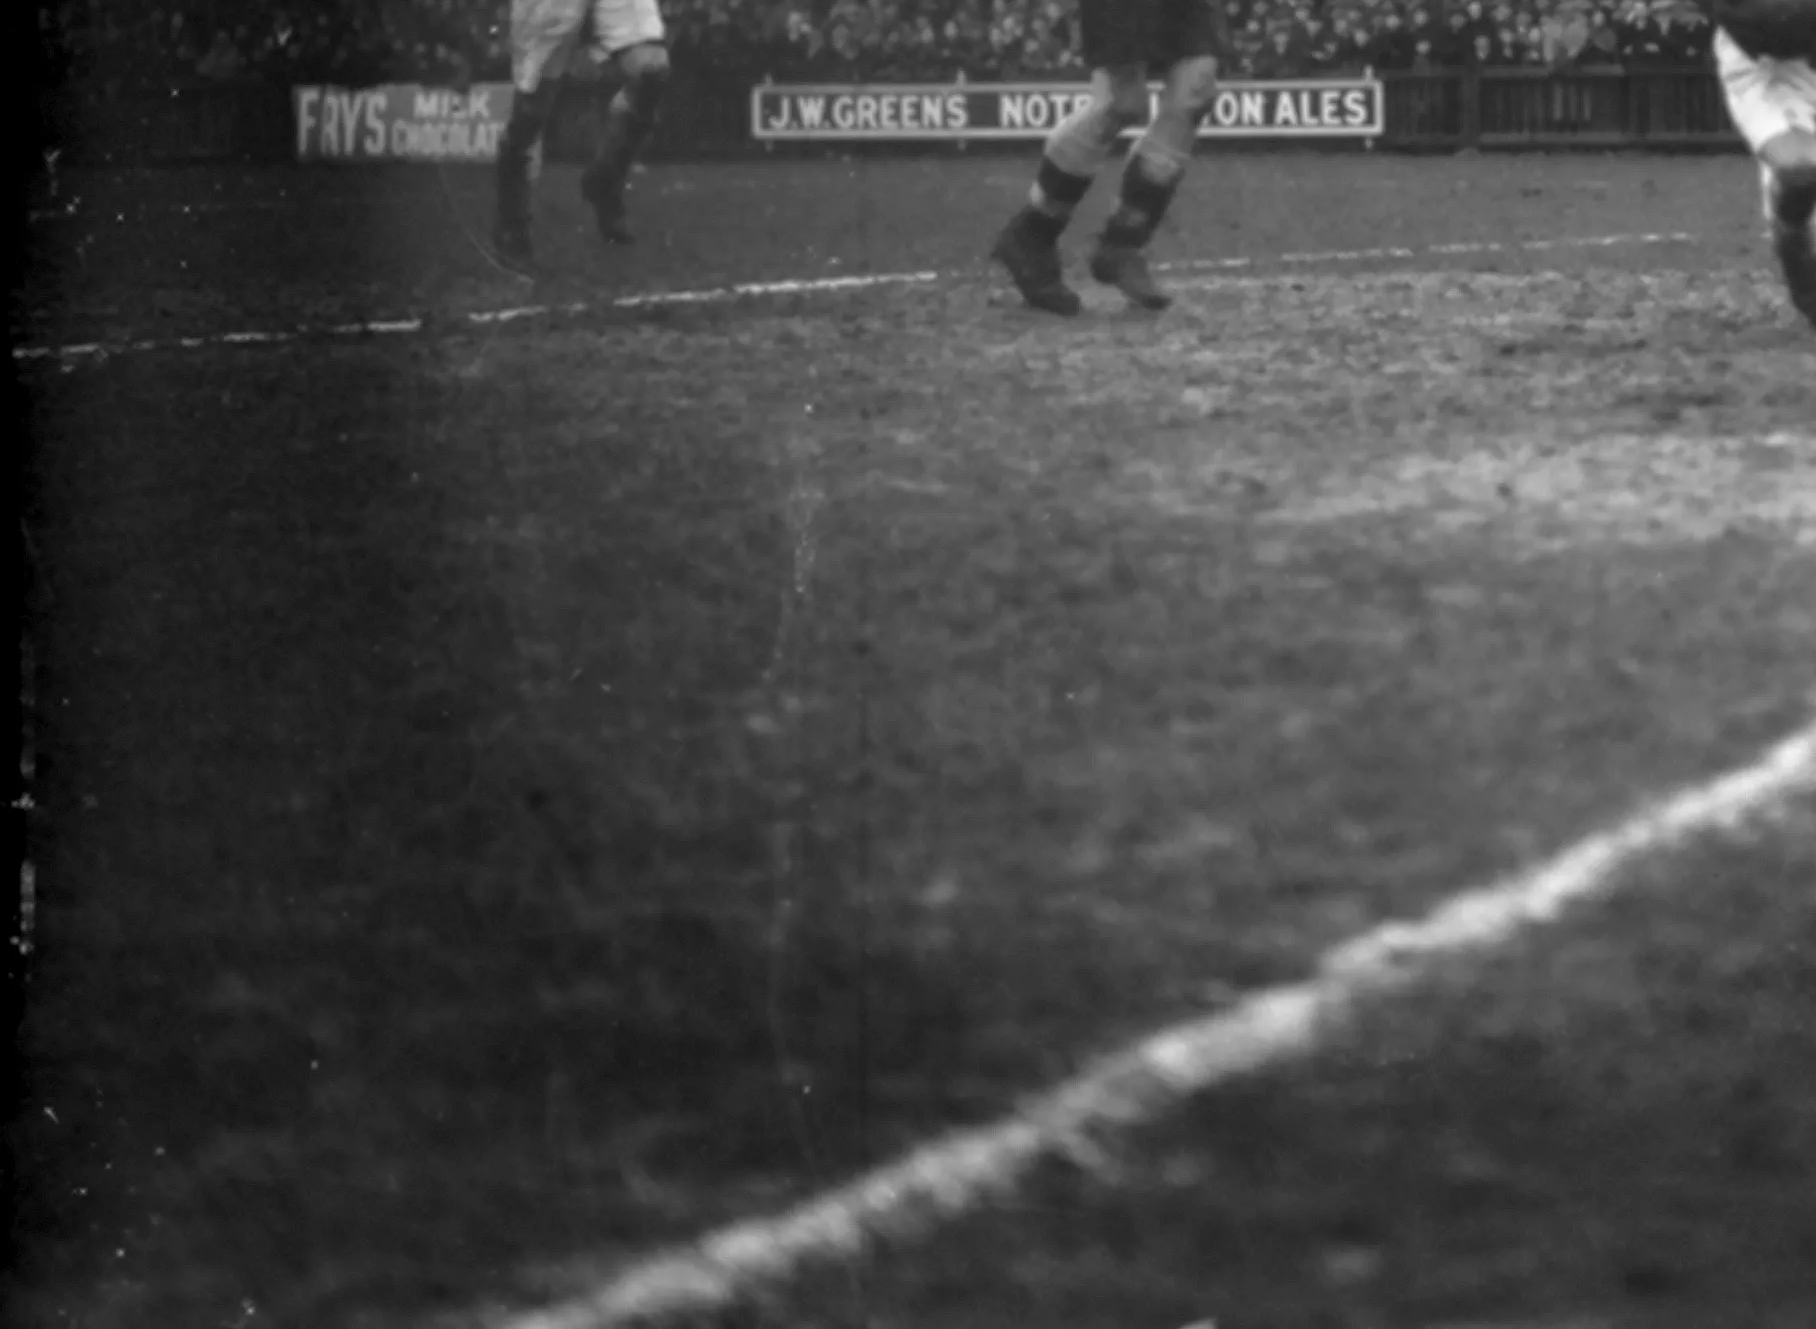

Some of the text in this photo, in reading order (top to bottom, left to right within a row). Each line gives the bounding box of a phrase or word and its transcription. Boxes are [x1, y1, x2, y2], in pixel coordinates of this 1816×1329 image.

[412, 90, 490, 119] MILK
[1275, 91, 1369, 127] ALES
[391, 119, 507, 156] CHOCOLAT
